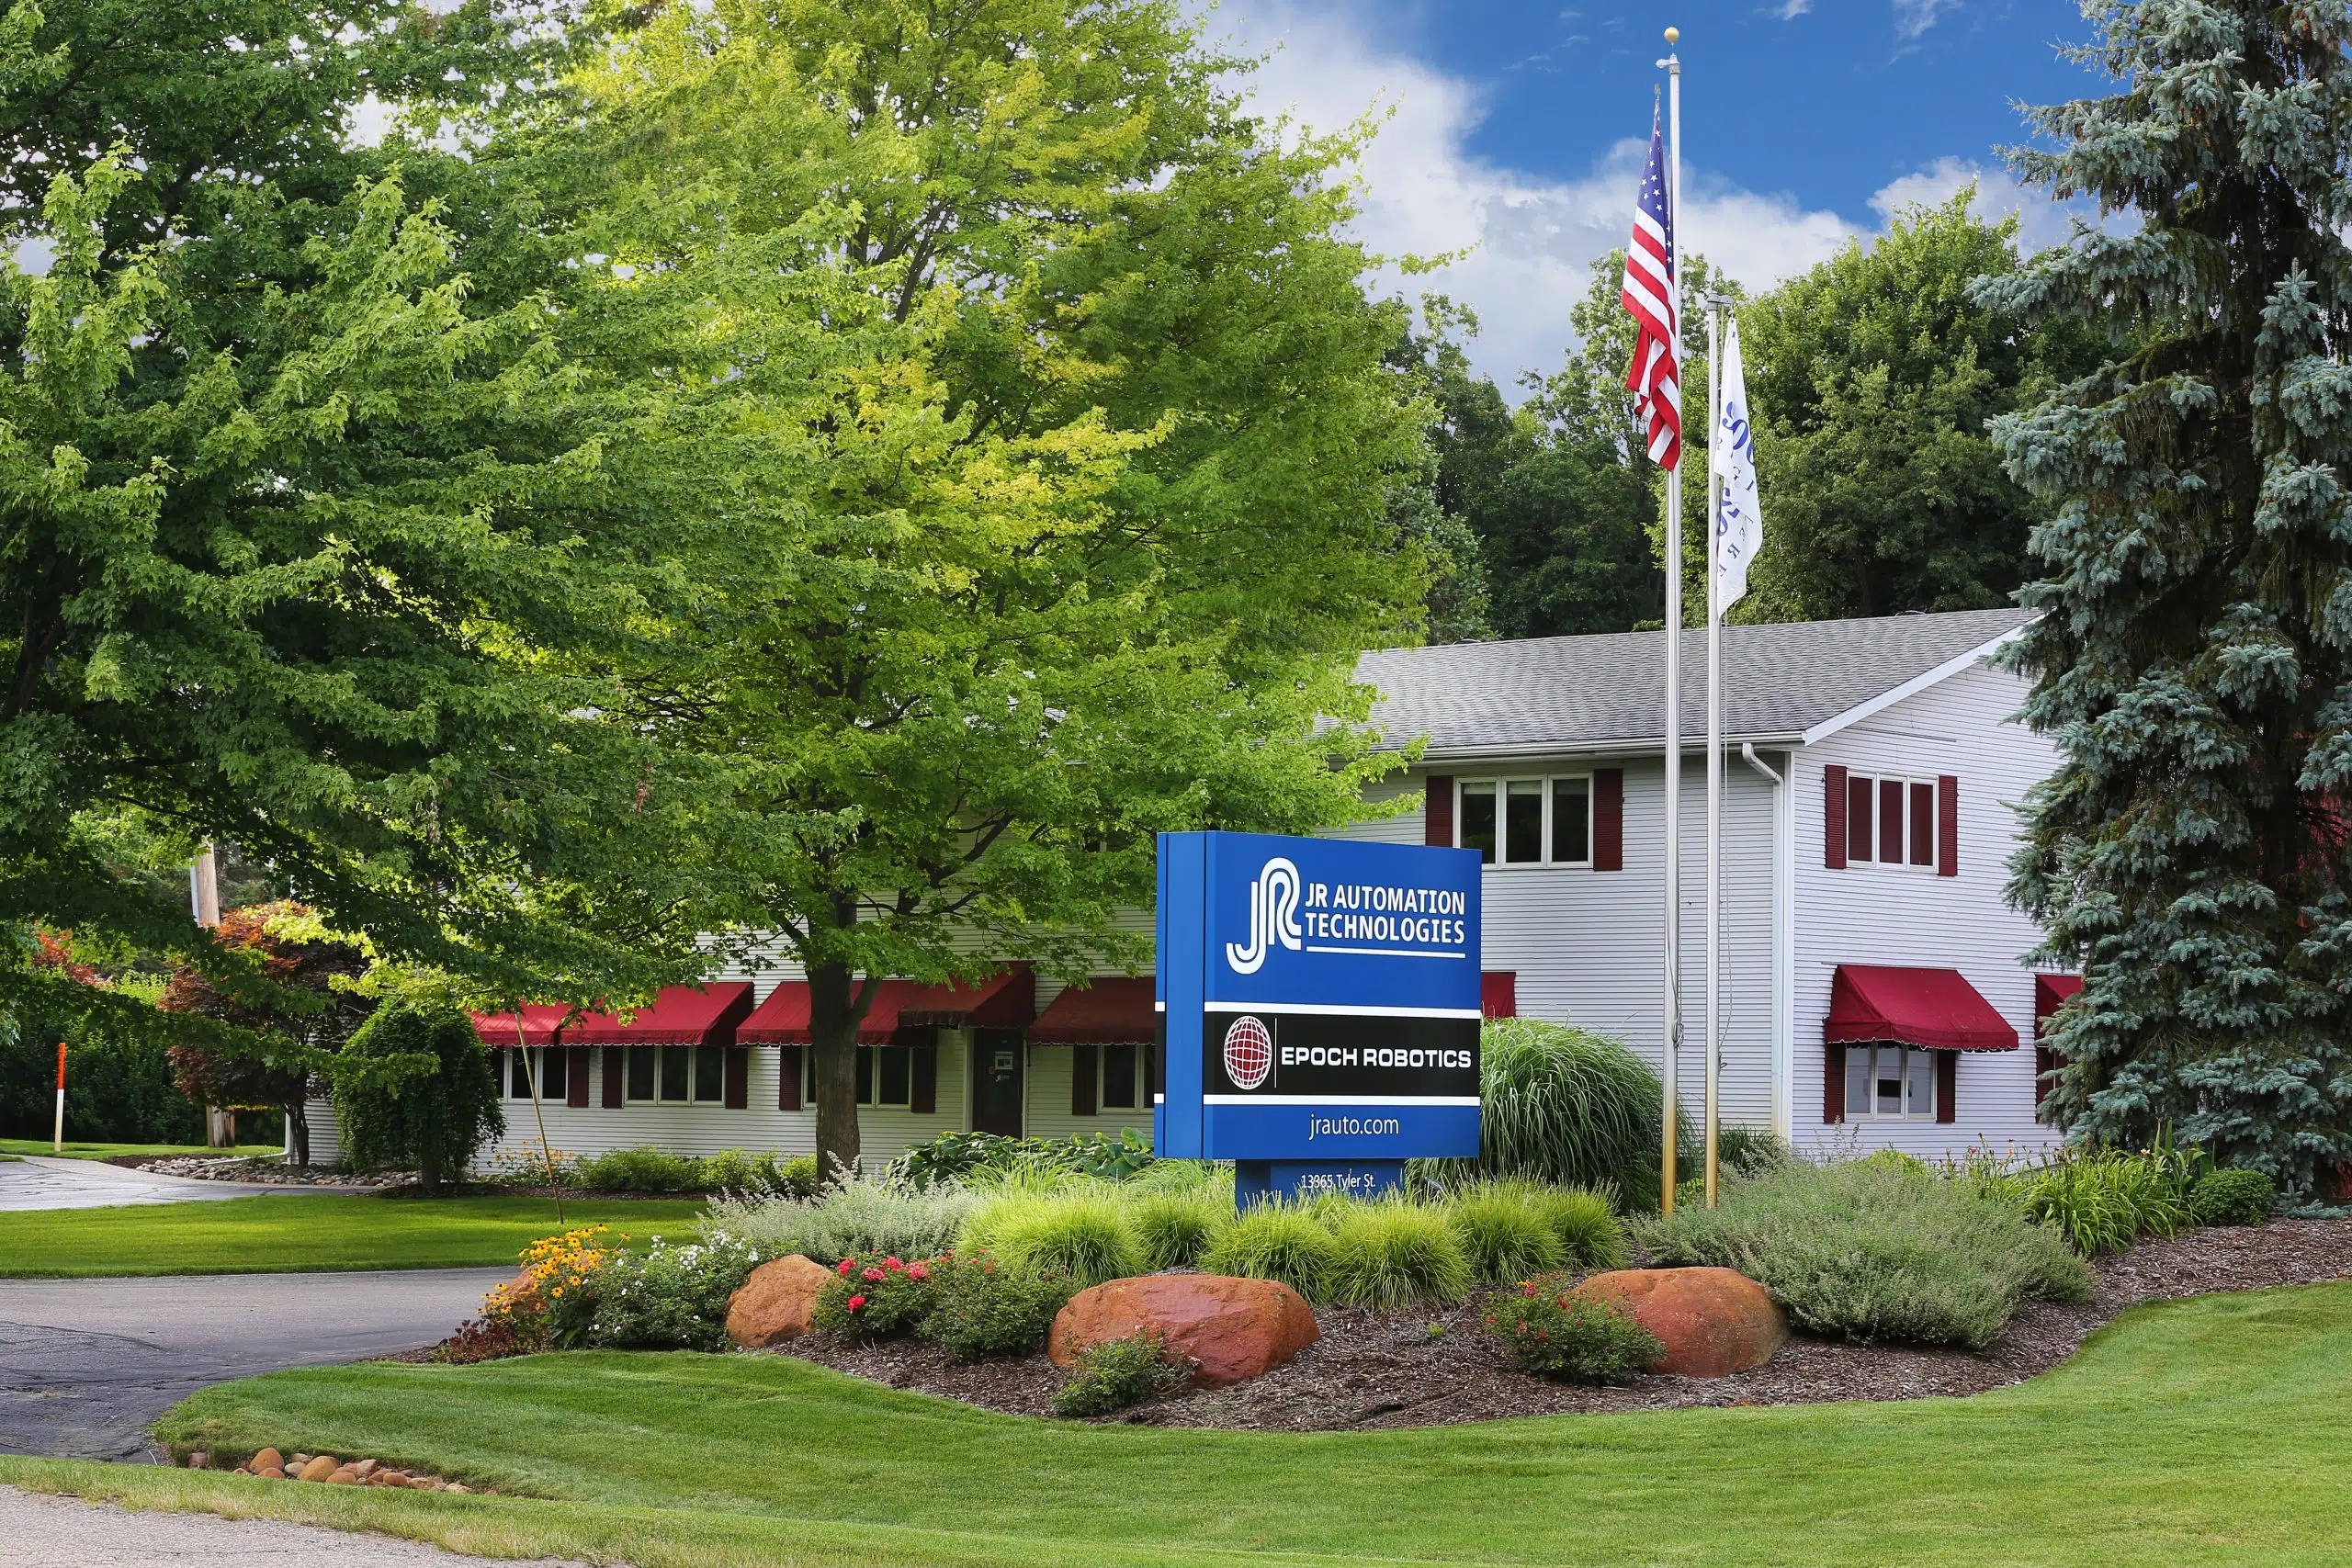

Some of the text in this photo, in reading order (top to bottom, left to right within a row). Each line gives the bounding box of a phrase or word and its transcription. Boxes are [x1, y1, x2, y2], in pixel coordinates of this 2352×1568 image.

[1305, 883, 1464, 915] JR AUTOMATION
[1305, 911, 1464, 944] TECHNOLOGIES
[1281, 1046, 1472, 1068] EPOCH ROBOTICS
[1308, 1113, 1399, 1140] jrauto.com
[1336, 1173, 1362, 1192] Tyler
[1363, 1173, 1376, 1188] St.
